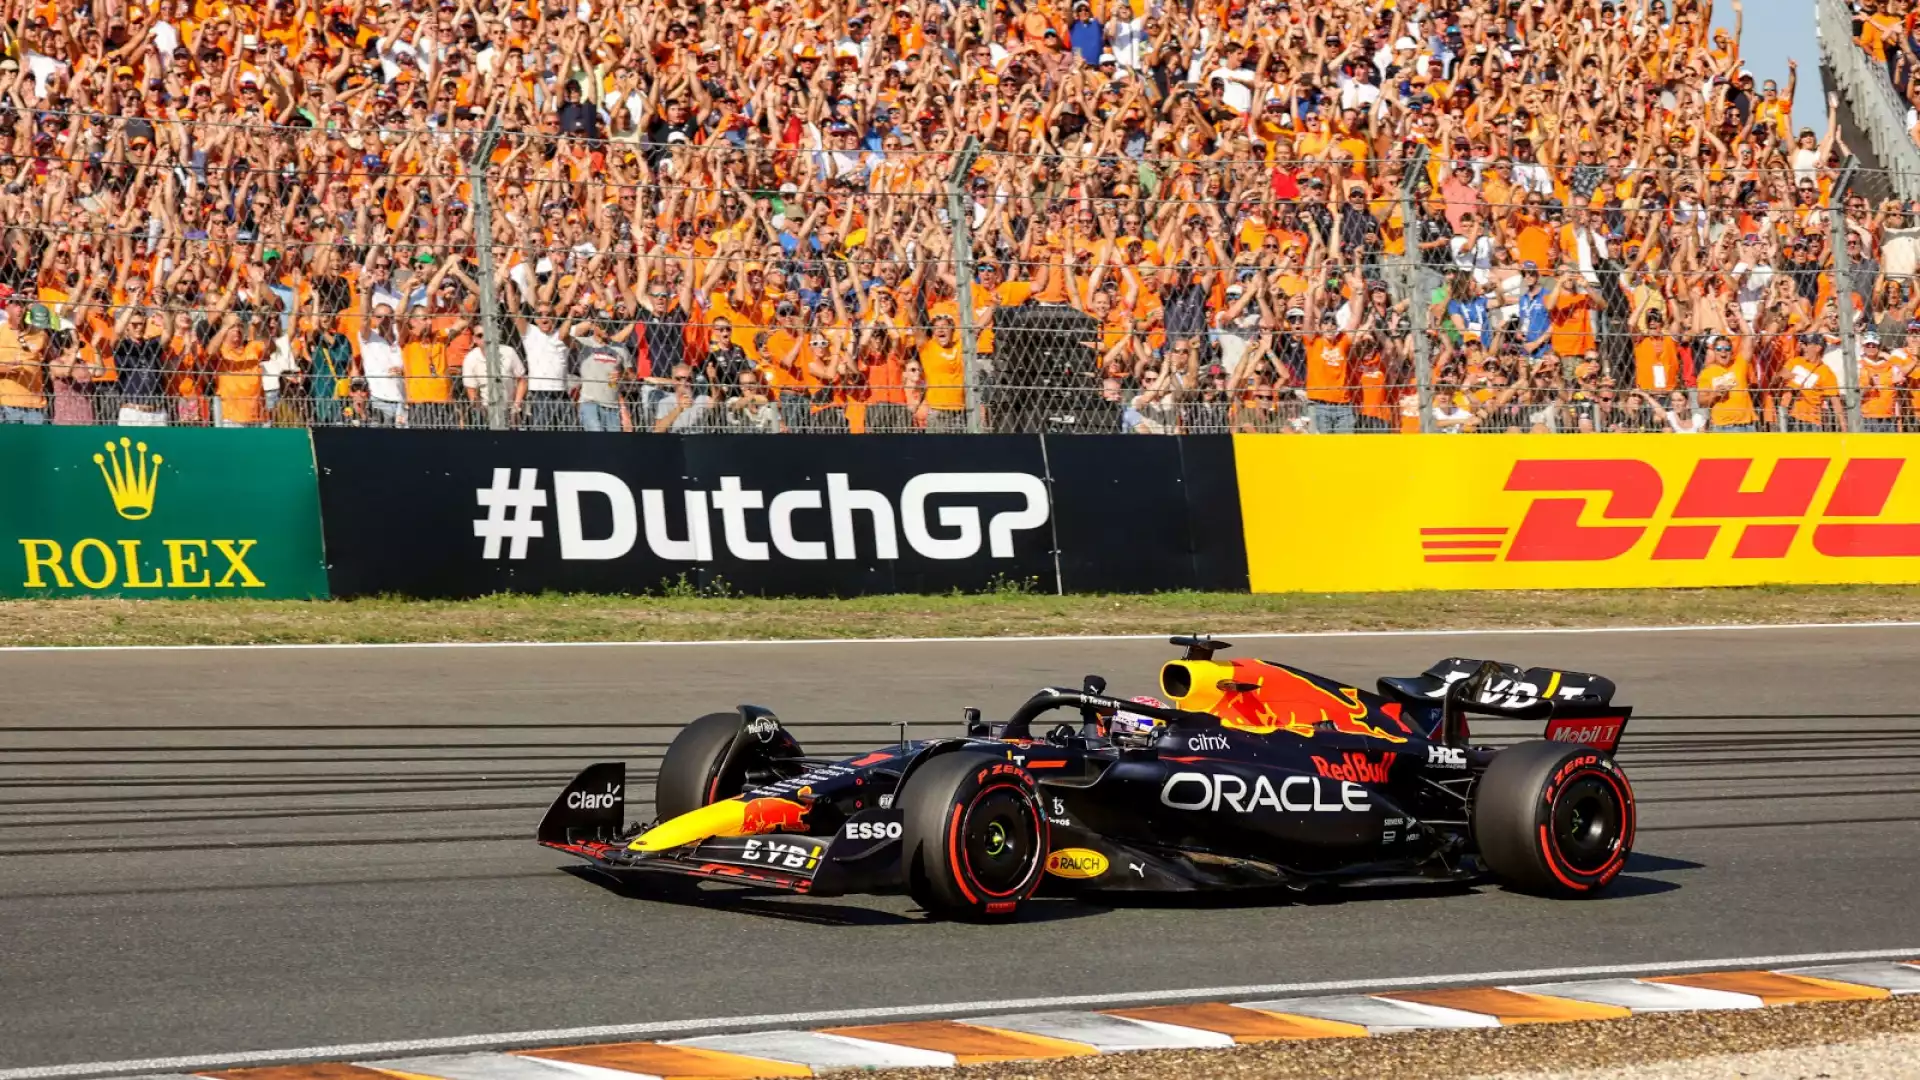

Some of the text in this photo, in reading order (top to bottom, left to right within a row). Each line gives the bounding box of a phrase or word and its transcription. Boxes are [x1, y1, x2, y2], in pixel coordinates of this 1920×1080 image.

[473, 466, 1050, 562] #DutchGP
[1502, 457, 1920, 562] DHL
[19, 538, 266, 588] ROLEX
[1188, 734, 1231, 751] citrix
[1553, 725, 1602, 744] Mobil
[1427, 744, 1467, 764] HRC
[977, 763, 1035, 786] P ZERO
[567, 790, 614, 809] Claro
[1160, 772, 1372, 812] ORACLE
[845, 821, 902, 839] ESSO
[1059, 857, 1100, 870] RAUCH
